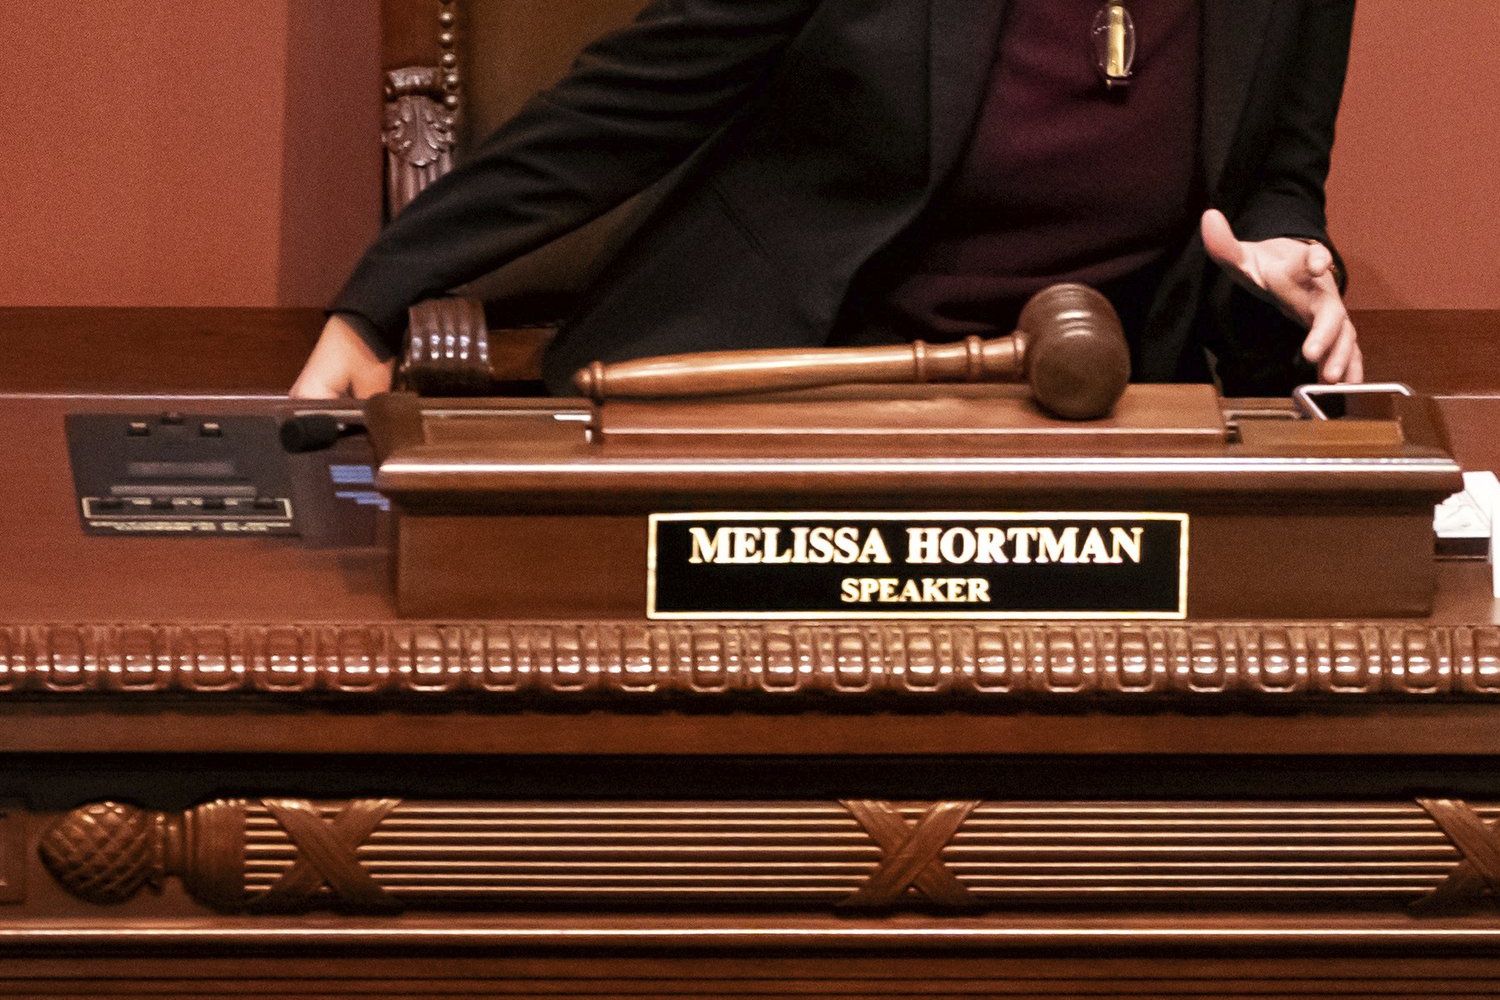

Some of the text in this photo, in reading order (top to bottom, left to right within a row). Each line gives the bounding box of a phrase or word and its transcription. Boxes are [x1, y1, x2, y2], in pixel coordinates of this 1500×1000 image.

[689, 527, 1143, 564] MELISSA HORTMAN
[841, 578, 990, 602] SPEAKER
